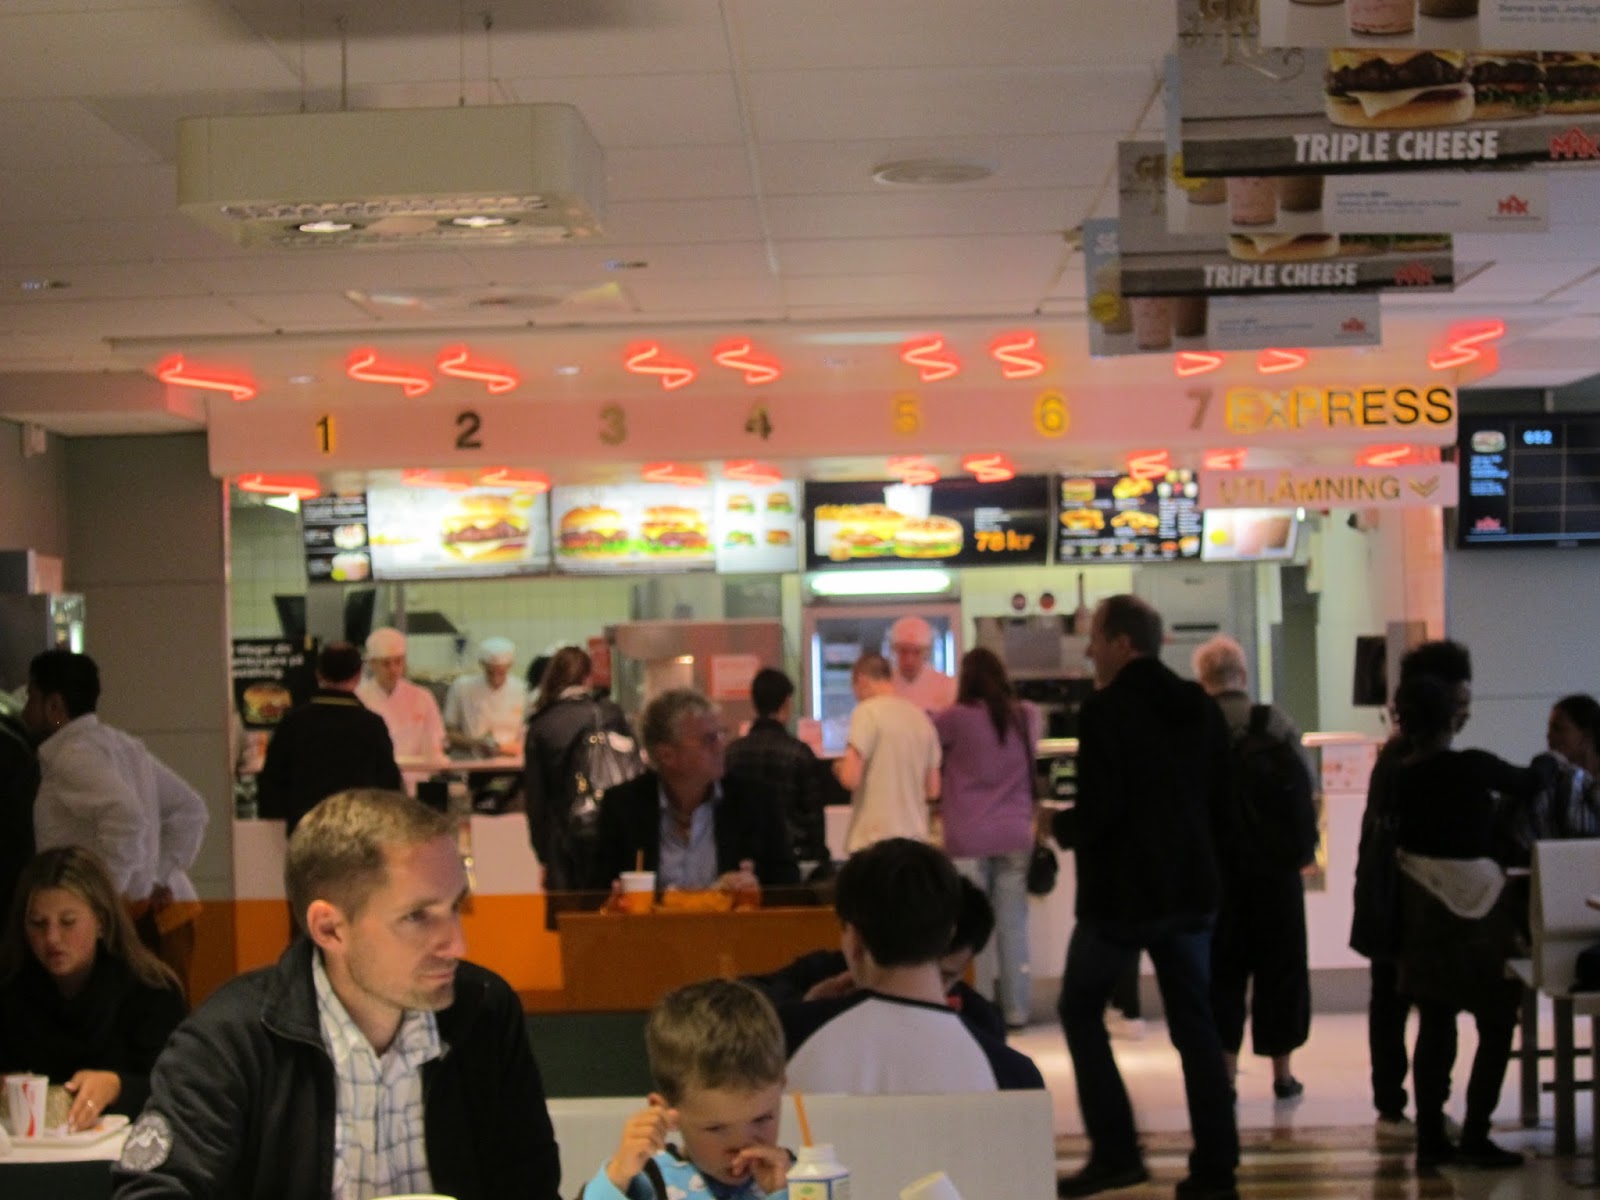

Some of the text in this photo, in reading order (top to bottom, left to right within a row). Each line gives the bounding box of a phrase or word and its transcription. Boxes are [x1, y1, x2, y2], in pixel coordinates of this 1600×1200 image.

[1294, 130, 1499, 162] TRIPLE CHEESE
[1203, 263, 1358, 288] TRIPLE CHEESE
[600, 405, 627, 445] 3
[744, 403, 773, 441] 4
[893, 394, 920, 436] 5
[1037, 391, 1067, 435] 6
[1185, 385, 1453, 432] 7 EXPRESS
[316, 413, 334, 454] 1
[454, 410, 482, 450] 2
